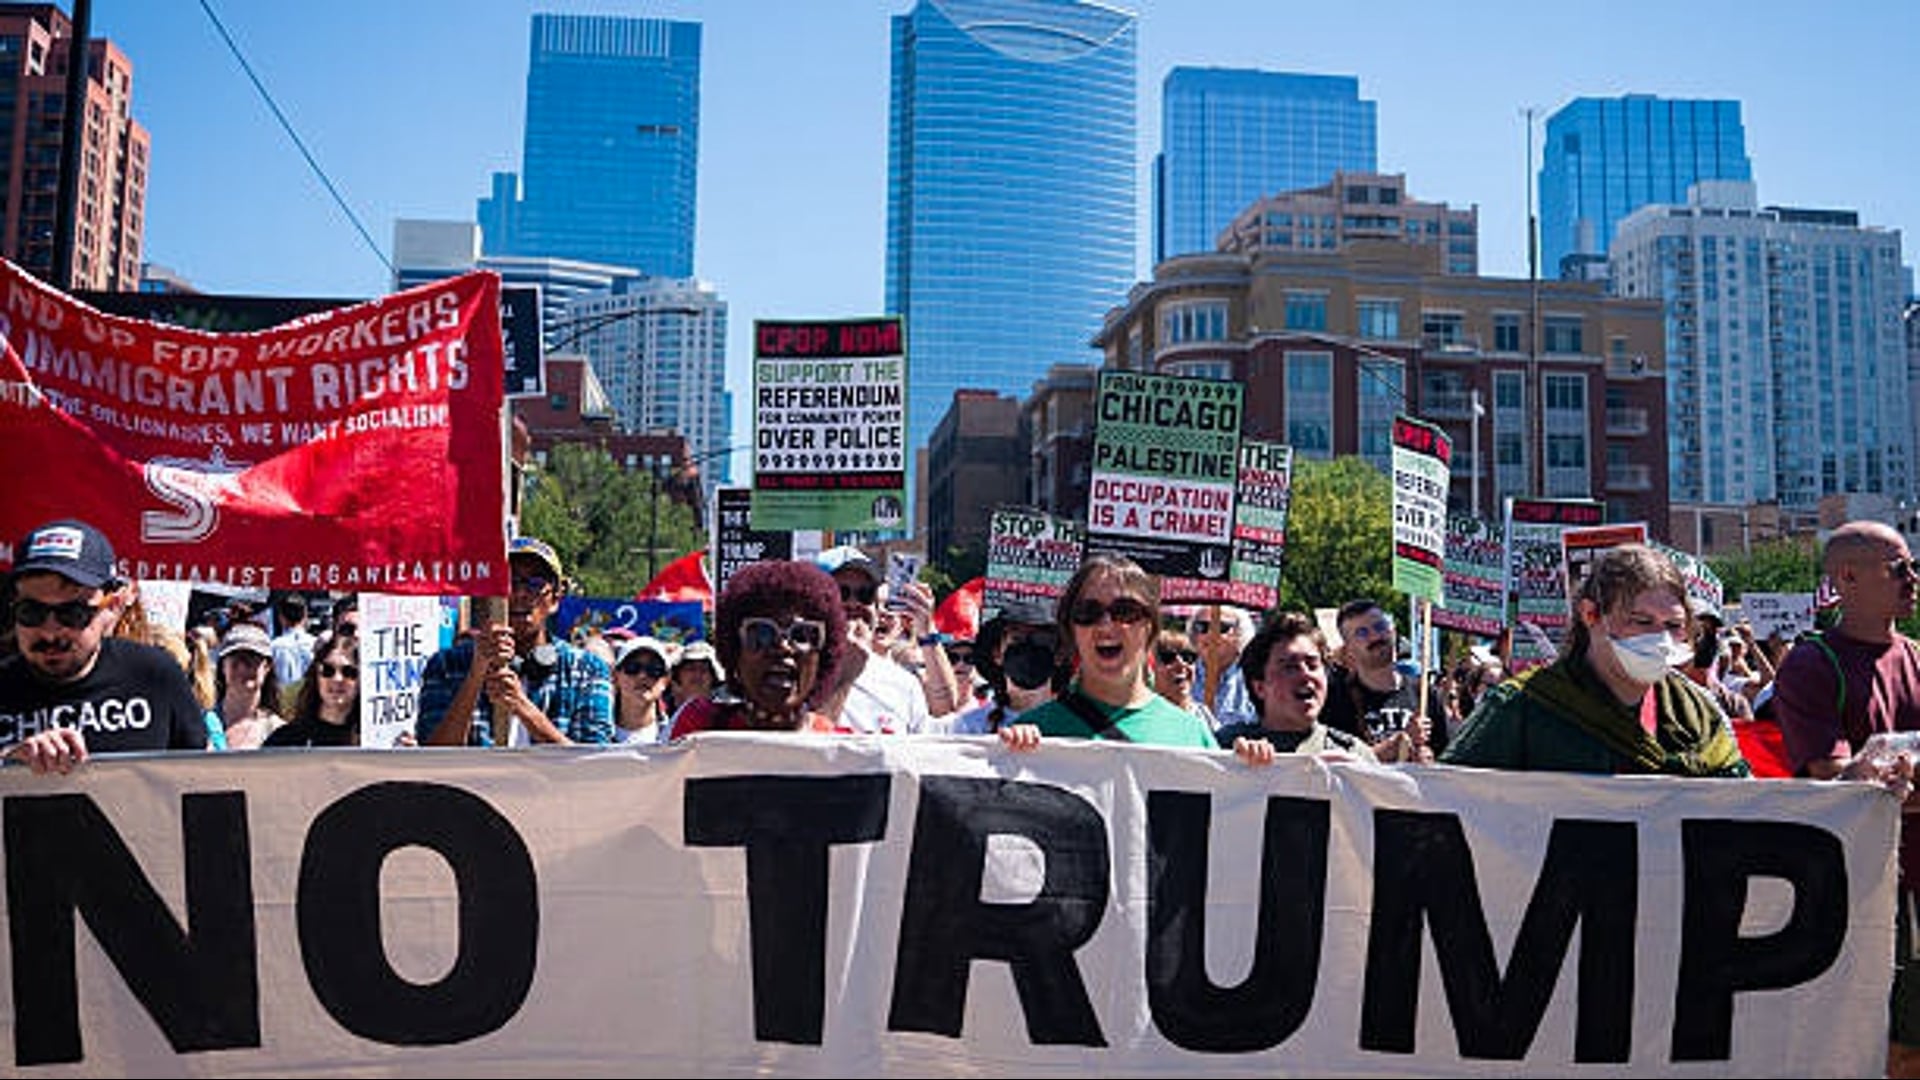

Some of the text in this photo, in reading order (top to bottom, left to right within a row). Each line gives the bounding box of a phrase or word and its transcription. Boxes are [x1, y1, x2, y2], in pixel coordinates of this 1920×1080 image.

[81, 314, 137, 349] UP
[153, 340, 239, 372] FOR
[257, 292, 460, 361] WORKERS
[24, 328, 293, 415] IMMIGRANT
[311, 338, 468, 410] RIGHTS
[758, 360, 900, 384] SUPPORT THE
[1104, 375, 1147, 392] FROM
[758, 385, 902, 409] REFERENDUM
[1101, 390, 1238, 432] CHICAGO
[241, 422, 273, 445] WE
[281, 419, 340, 445] WANT
[758, 411, 783, 425] FOR
[787, 410, 857, 425] COMMUNITY
[758, 426, 902, 449] OVER POLICE
[1097, 445, 1234, 478] PALESTINE
[1243, 445, 1288, 471] THE
[1093, 479, 1230, 512] OCCUPATION
[994, 514, 1047, 537] STOP
[1093, 504, 1115, 527] IS
[1123, 506, 1140, 529] A
[1150, 510, 1227, 538] CRIME!
[118, 557, 491, 589] SOCIALIST ORGANIZATION
[372, 623, 423, 659] THE
[0, 697, 151, 744] CHICAGO
[4, 773, 1850, 1067] NO TRUMP
